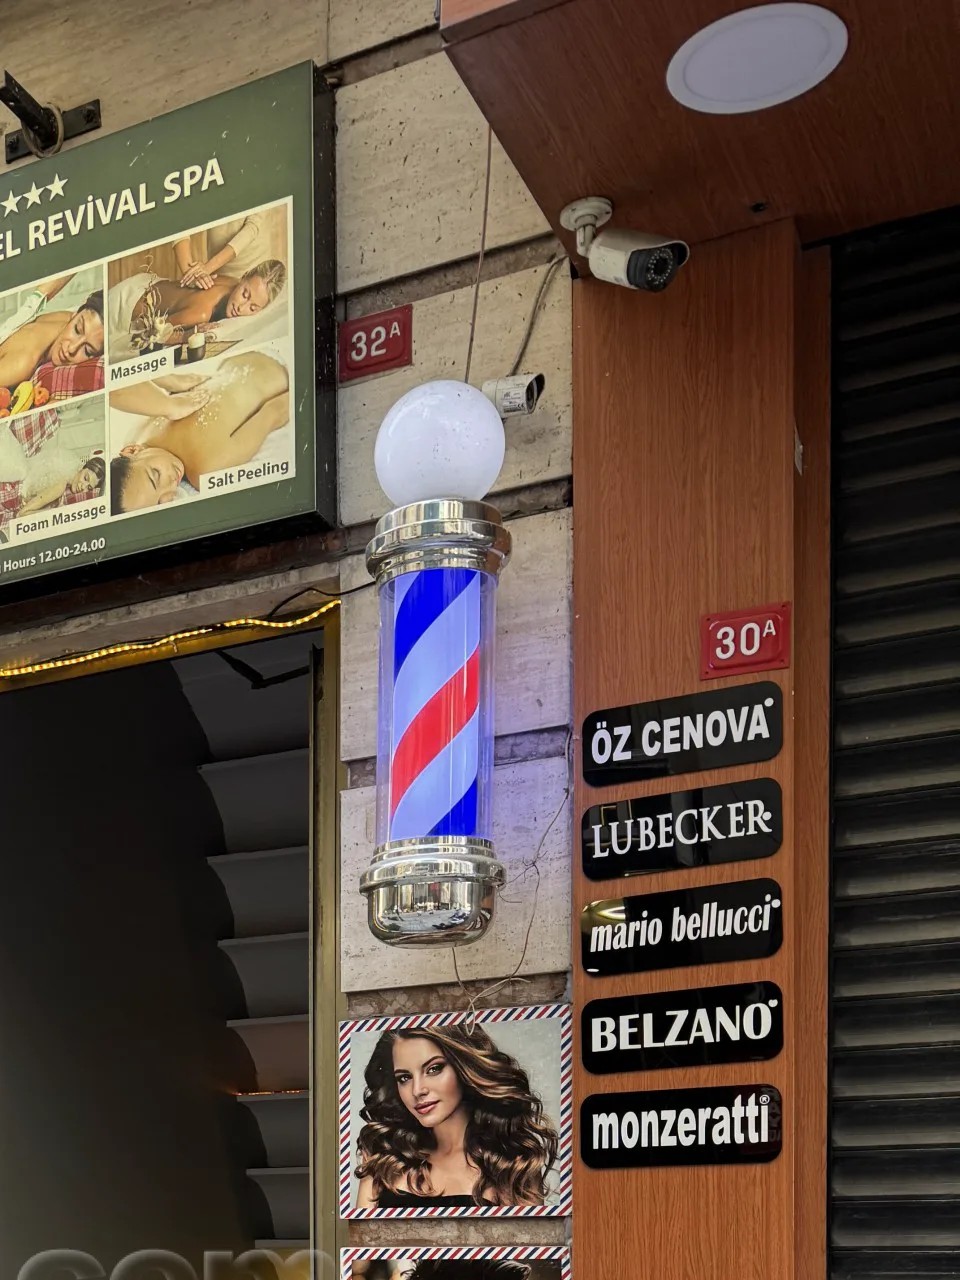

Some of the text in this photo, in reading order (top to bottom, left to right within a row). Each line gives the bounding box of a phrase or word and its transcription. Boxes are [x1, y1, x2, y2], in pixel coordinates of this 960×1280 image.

[163, 157, 225, 204] SPA
[110, 355, 168, 381] Massage
[207, 461, 289, 490] Salt Peeling
[16, 503, 106, 536] Foam Massage
[4, 555, 36, 573] Hours
[39, 537, 106, 564] 12.00-24.00
[591, 703, 770, 764] ÖZ CENOVA
[591, 799, 773, 858] LUBECKER
[590, 893, 771, 953] mario bellucci
[591, 1002, 773, 1053] BELZANO
